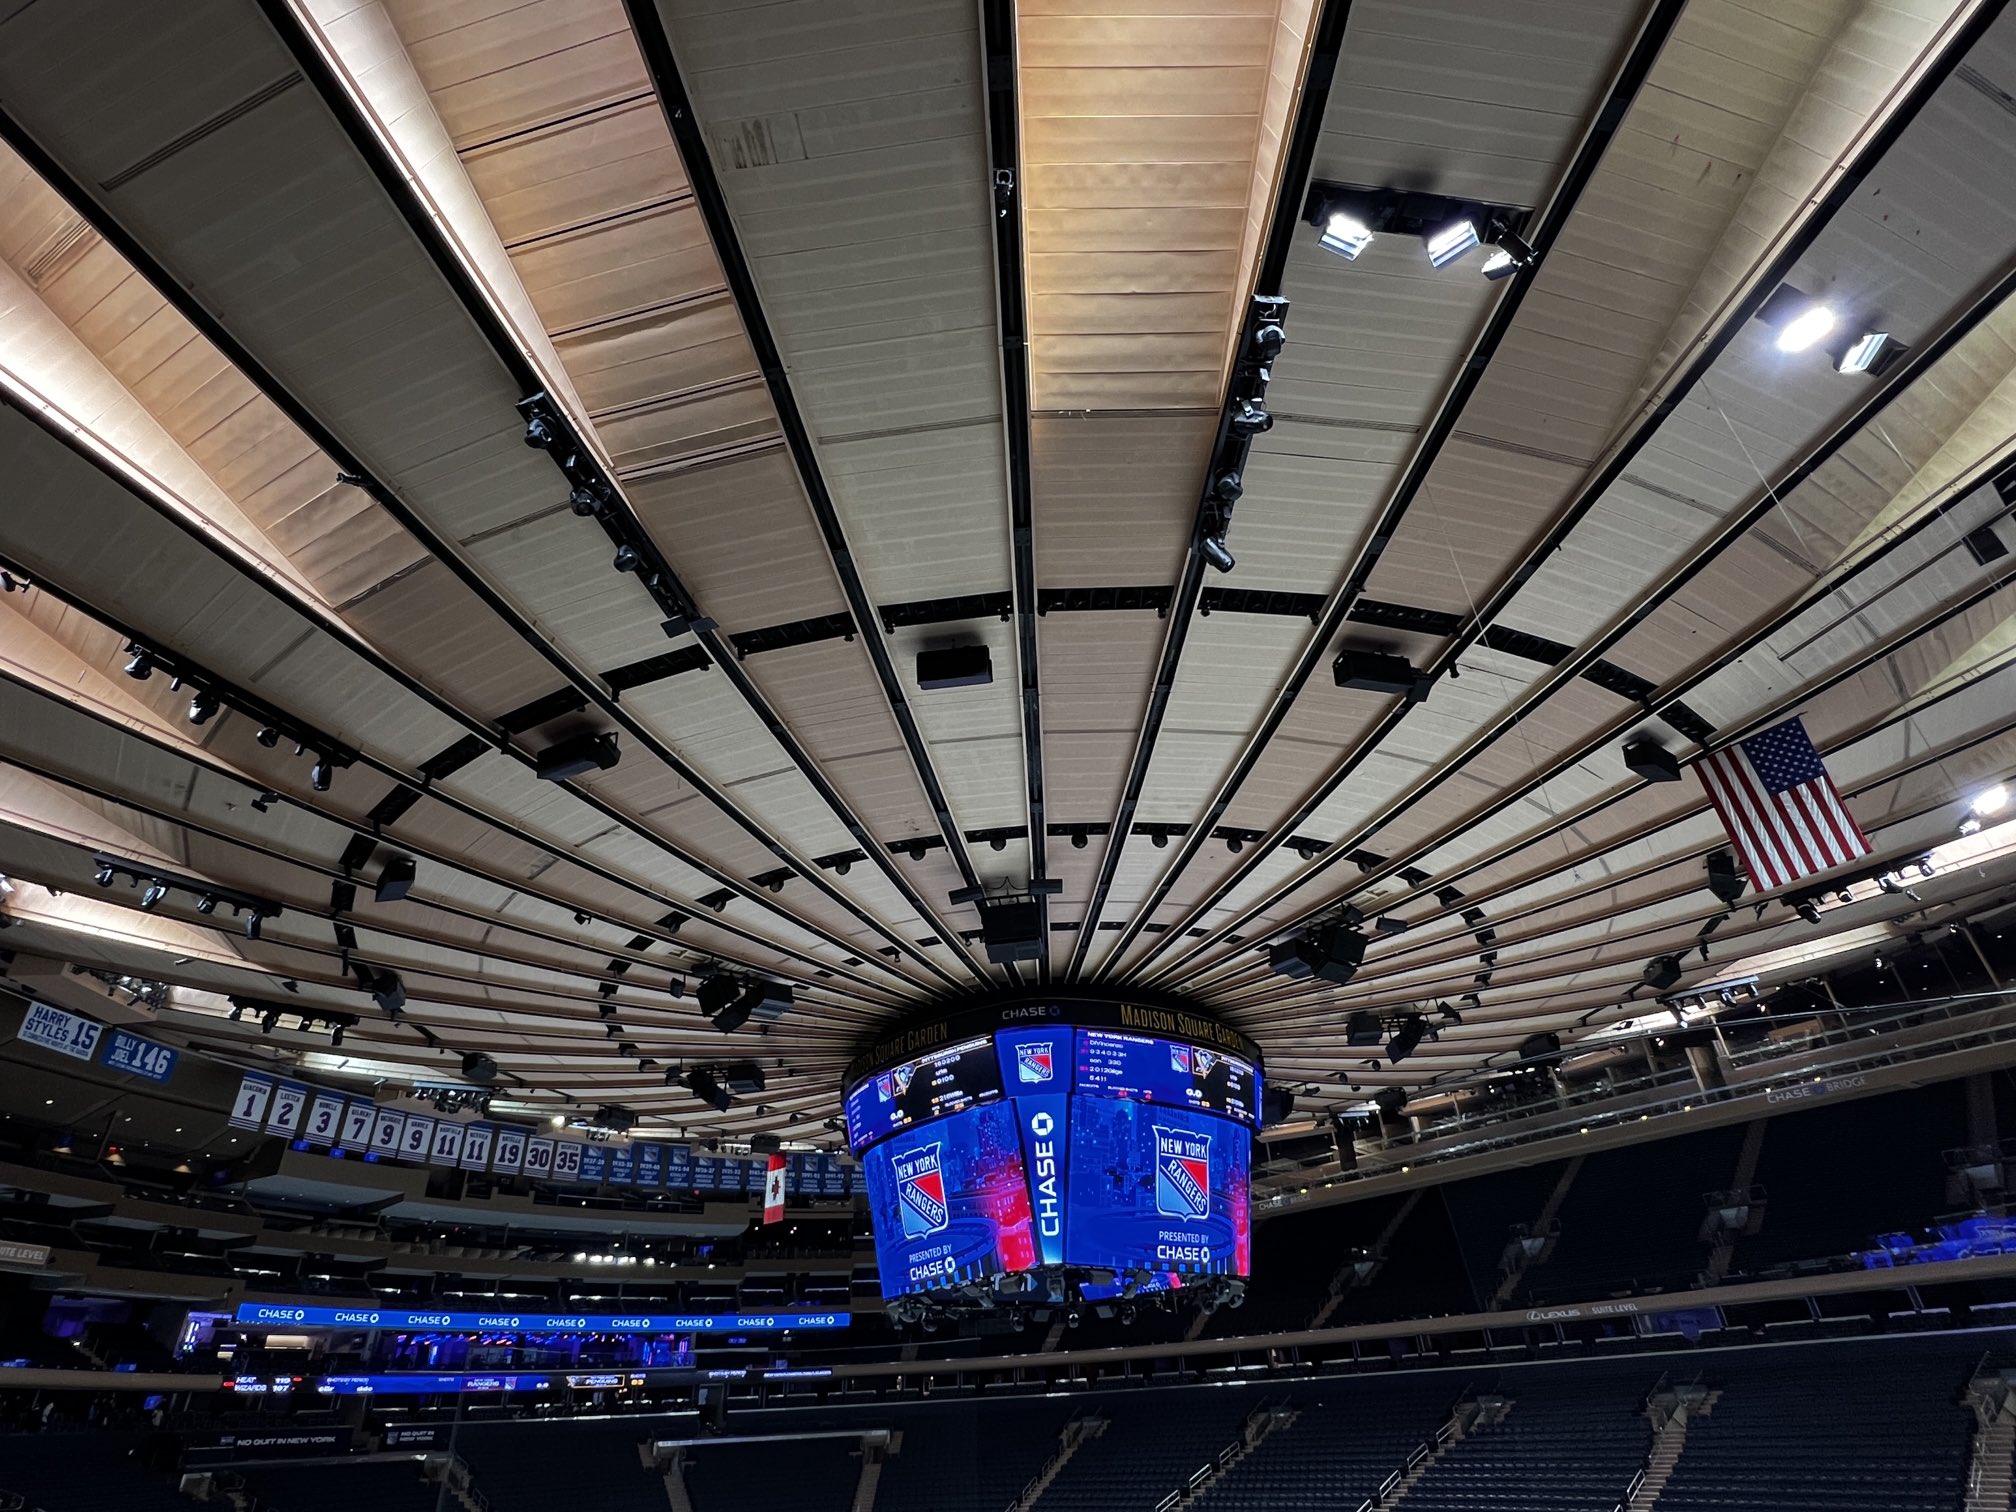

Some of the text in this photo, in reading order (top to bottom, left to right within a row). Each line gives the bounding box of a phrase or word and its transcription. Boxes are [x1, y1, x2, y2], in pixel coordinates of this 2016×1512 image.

[33, 1006, 72, 1028] HARRY
[1002, 1006, 1046, 1020] CHASE
[25, 1018, 69, 1042] STYLES
[1121, 1004, 1175, 1032] MADISON
[1178, 1013, 1216, 1043] SQUARE
[70, 1021, 99, 1050] 15
[875, 1036, 905, 1064] SQUARE
[908, 1022, 948, 1051] GARDEN
[1087, 1031, 1154, 1045] NEW YORK RANGERS
[131, 1042, 171, 1075] 146
[1024, 1057, 1050, 1078] RANGERS
[1767, 1077, 1868, 1104] CHASE BRIDGE
[243, 1094, 256, 1117] 1
[278, 1103, 293, 1125] 2
[316, 1111, 331, 1133] 3
[353, 1118, 366, 1139] 7
[381, 1124, 394, 1145] 9
[409, 1130, 423, 1150] 9
[437, 1135, 456, 1155] 11
[467, 1140, 484, 1160] 11
[498, 1143, 520, 1164] 19
[1160, 1137, 1207, 1159] NEW YORK
[528, 1147, 550, 1168] 30
[556, 1151, 579, 1171] 35
[898, 1154, 938, 1179] NEW YORK
[1035, 1141, 1060, 1237] CHASE
[1168, 1159, 1207, 1212] RANGERS
[905, 1182, 944, 1223] RANGERS
[1159, 1231, 1209, 1244] PRESENTED BY
[17, 1249, 44, 1260] LEVEL
[909, 1244, 952, 1264] PRESENTED BY
[1157, 1245, 1200, 1261] CHASE
[910, 1260, 944, 1281] CHASE
[258, 1308, 293, 1319] CHASE
[335, 1312, 369, 1322] CHASE
[1541, 1310, 1581, 1320] LEXUS
[1592, 1303, 1638, 1314] SUITE LEVEL
[408, 1315, 442, 1325] CHASE
[478, 1317, 511, 1327] CHASE
[546, 1318, 576, 1327] CHASE
[612, 1319, 641, 1328] CHASE
[676, 1319, 704, 1327] CHASE
[737, 1318, 766, 1327] CHASE
[799, 1316, 826, 1325] CHASE
[236, 1376, 257, 1384] HEAT
[253, 1438, 276, 1446] QUIT
[287, 1437, 309, 1445] NEW
[310, 1436, 336, 1444] YORK
